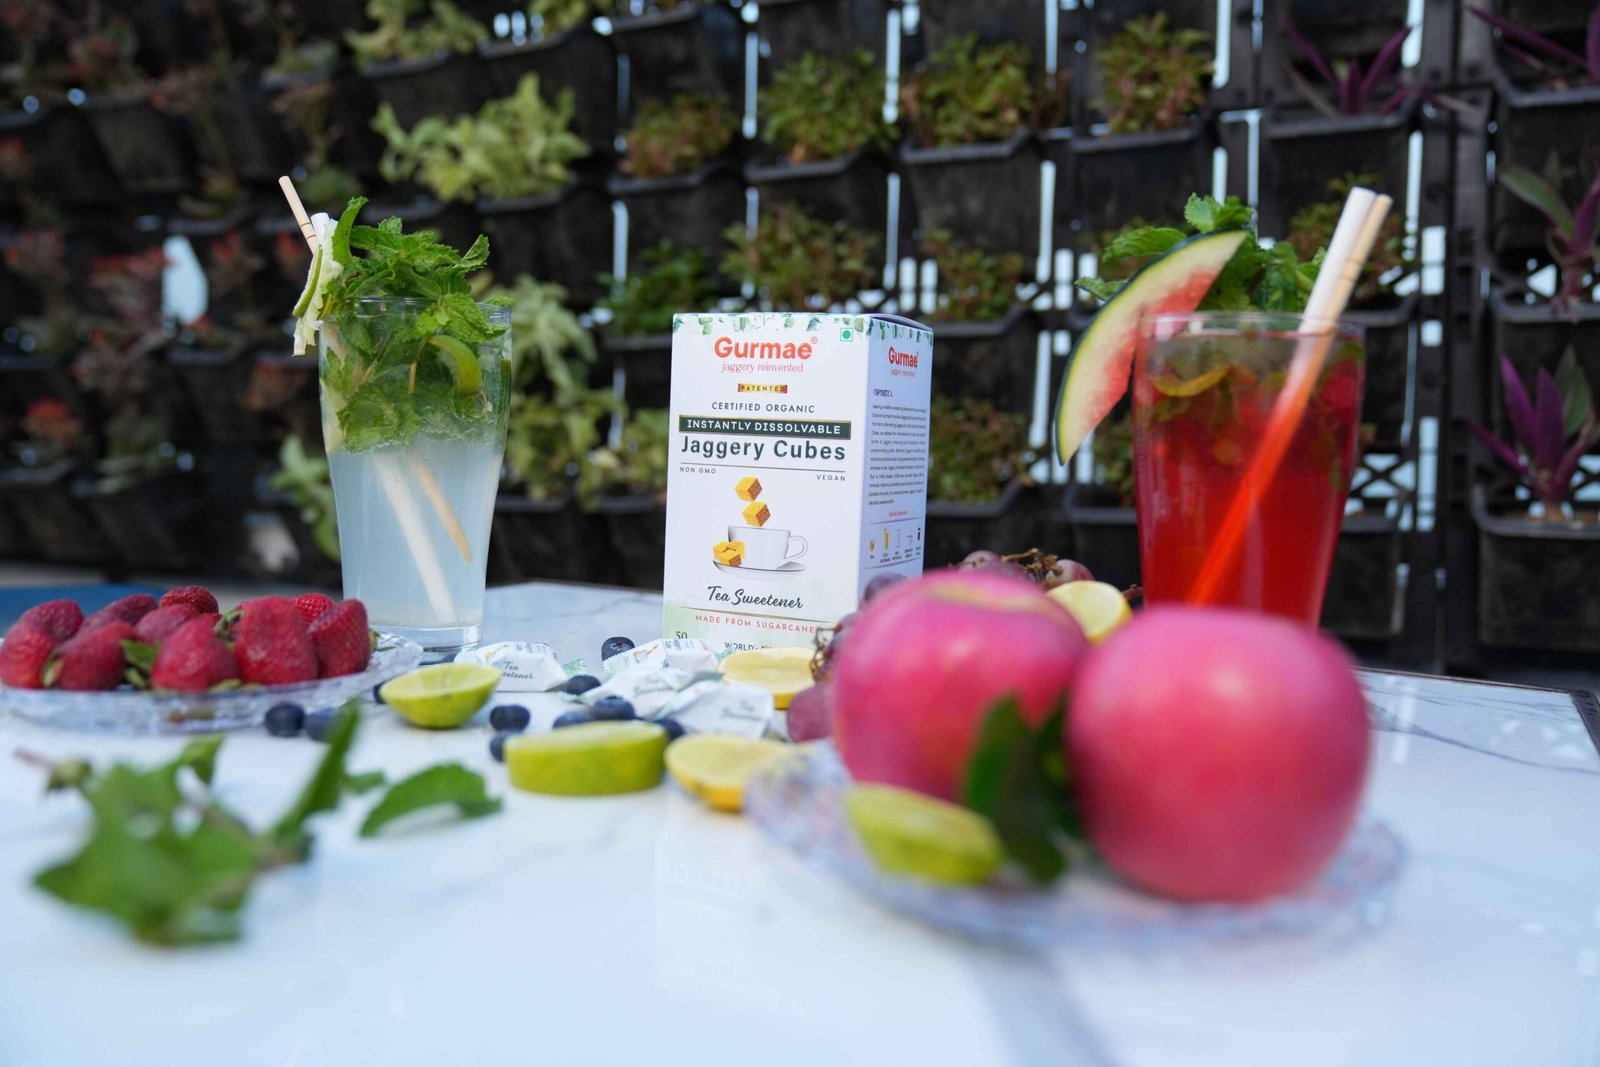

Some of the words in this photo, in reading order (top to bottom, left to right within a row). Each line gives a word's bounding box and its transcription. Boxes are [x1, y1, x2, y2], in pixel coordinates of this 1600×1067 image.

[721, 361, 755, 373] jaggery
[757, 362, 804, 373] reinvented
[740, 384, 785, 393] PATENTED
[711, 401, 761, 412] CERTIFIED
[766, 403, 815, 414] ORGANIC
[687, 419, 752, 432] INSTANTLY
[755, 421, 841, 435] DISSOLVABLE
[681, 436, 765, 461] Jaggery
[774, 440, 846, 460] Cubes
[816, 474, 846, 482] VEGAN
[707, 586, 730, 603] Tea
[731, 589, 804, 610] Sweetener
[695, 615, 721, 625] MADE
[725, 617, 752, 627] FROM
[756, 620, 816, 634] SUGARCANE
[503, 661, 519, 671] Tea
